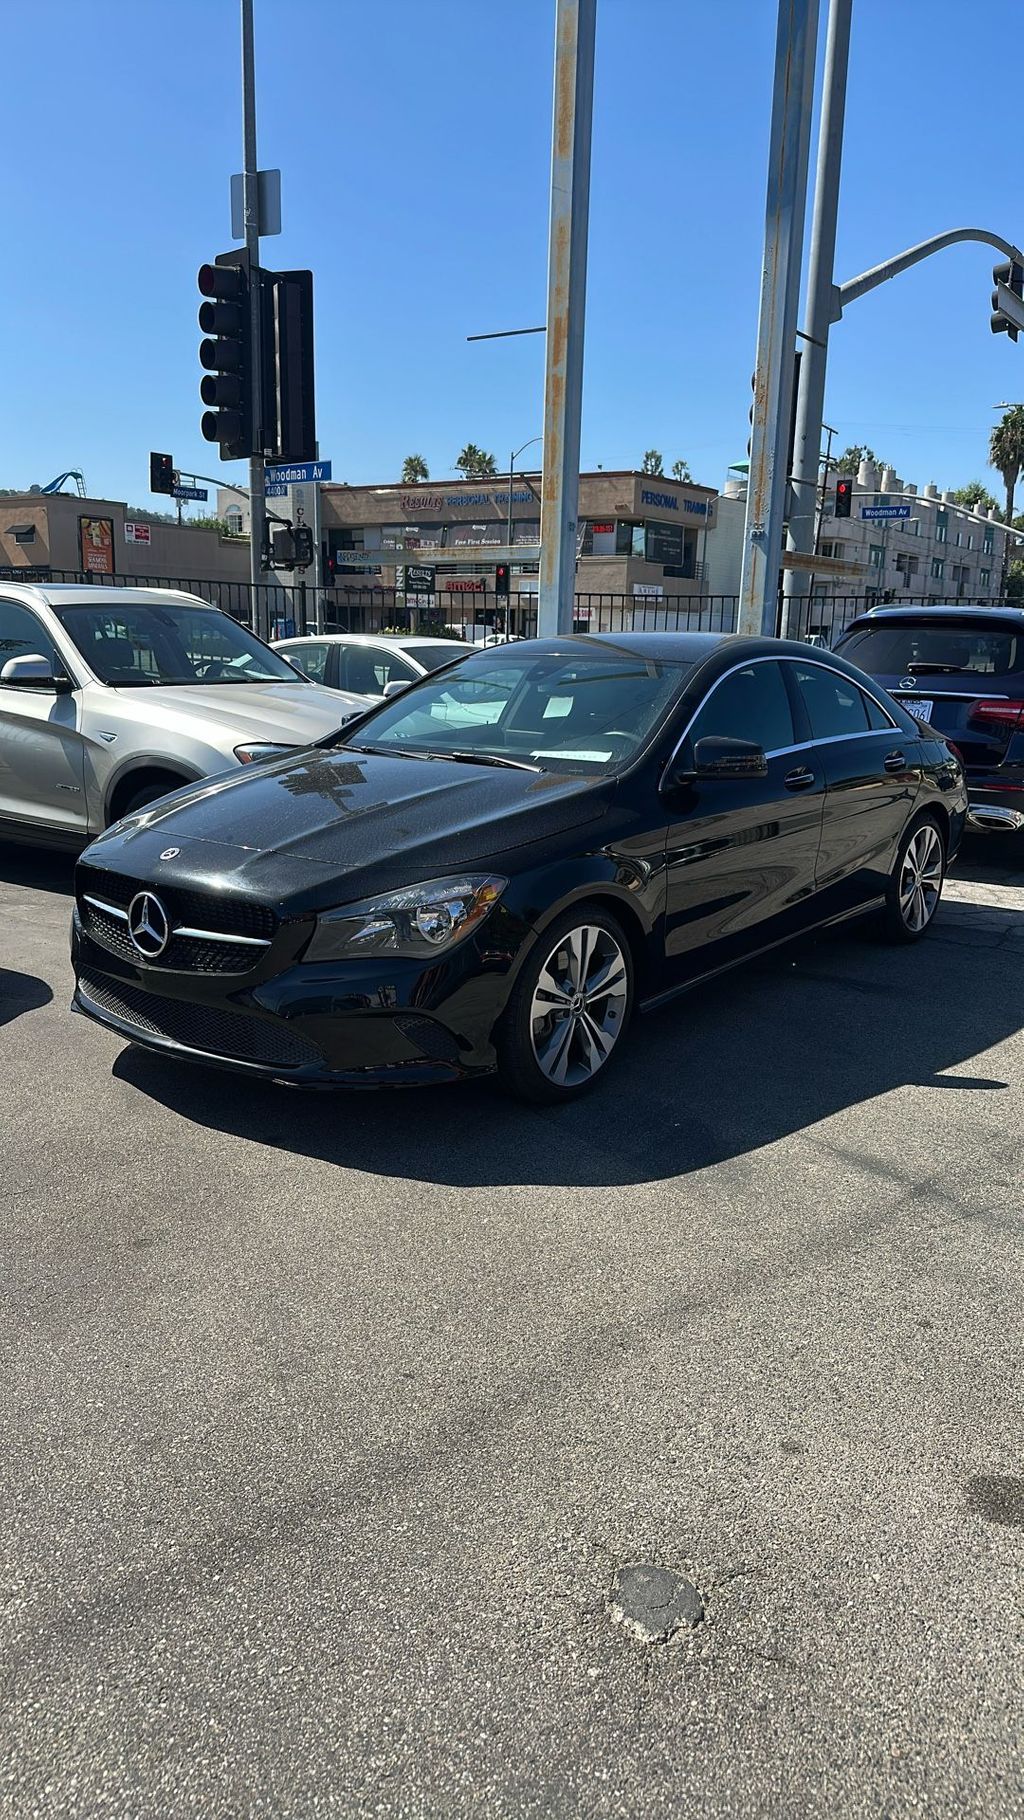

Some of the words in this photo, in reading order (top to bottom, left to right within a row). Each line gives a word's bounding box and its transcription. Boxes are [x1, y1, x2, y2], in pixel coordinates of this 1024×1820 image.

[270, 468, 307, 482] Woodman
[312, 465, 323, 479] Av
[173, 488, 198, 498] Moorpark
[199, 491, 206, 499] St
[446, 493, 490, 506] PERSONAL
[495, 491, 535, 504] TRANING
[641, 490, 679, 511] PERSONAL
[865, 509, 897, 517] Woodman
